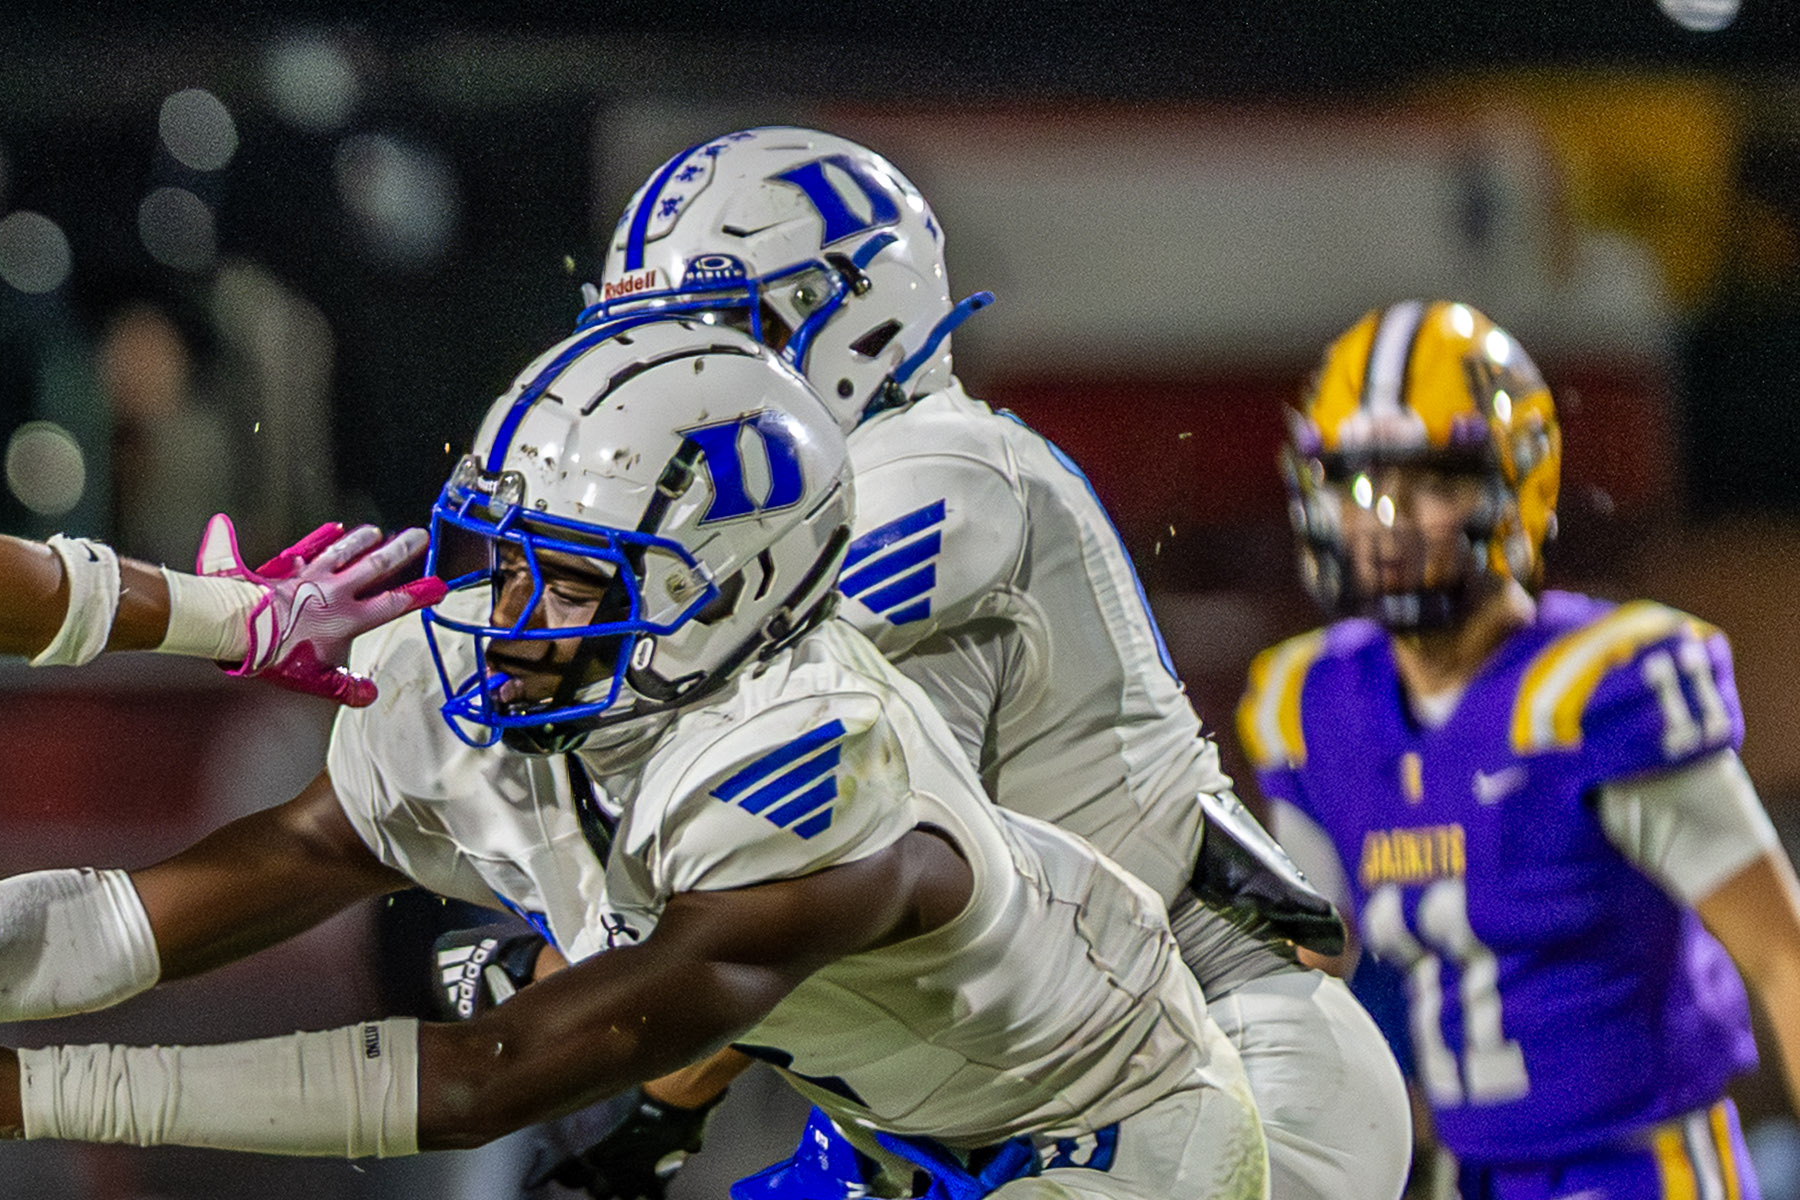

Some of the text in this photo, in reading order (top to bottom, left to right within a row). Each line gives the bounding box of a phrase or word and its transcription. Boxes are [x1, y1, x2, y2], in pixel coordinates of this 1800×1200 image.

[768, 153, 900, 249] D
[674, 407, 804, 527] D
[457, 937, 499, 1019] adidas
[1360, 880, 1530, 1106] 11
